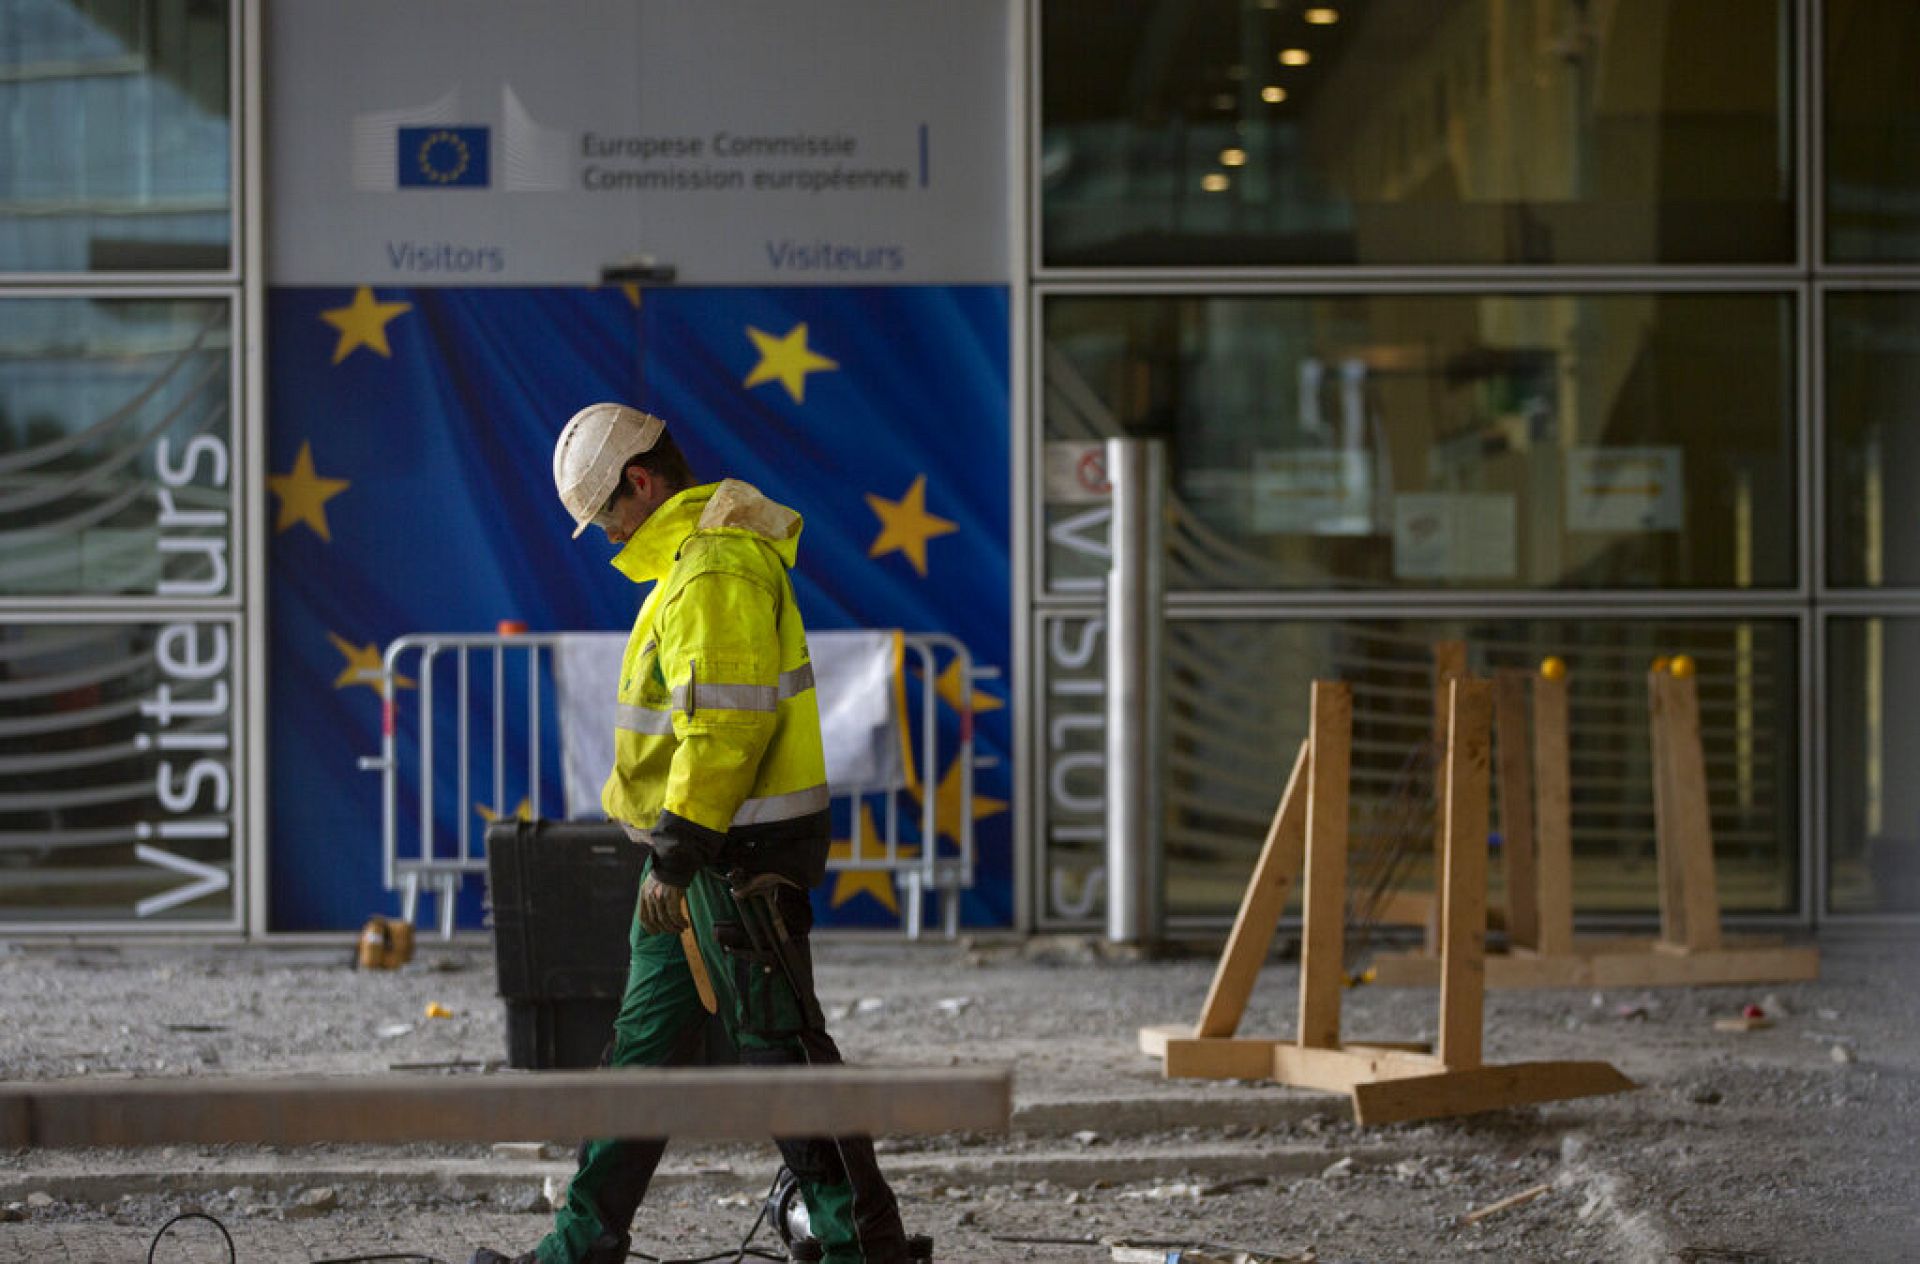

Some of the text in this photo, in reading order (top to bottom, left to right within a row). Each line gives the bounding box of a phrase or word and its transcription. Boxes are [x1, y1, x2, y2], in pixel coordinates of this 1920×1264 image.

[581, 131, 857, 158] Europese Commissie
[582, 163, 908, 193] Commission européenne
[387, 240, 504, 271] Visitors
[766, 238, 904, 270] Visiteurs
[135, 434, 230, 917] Visiteurs
